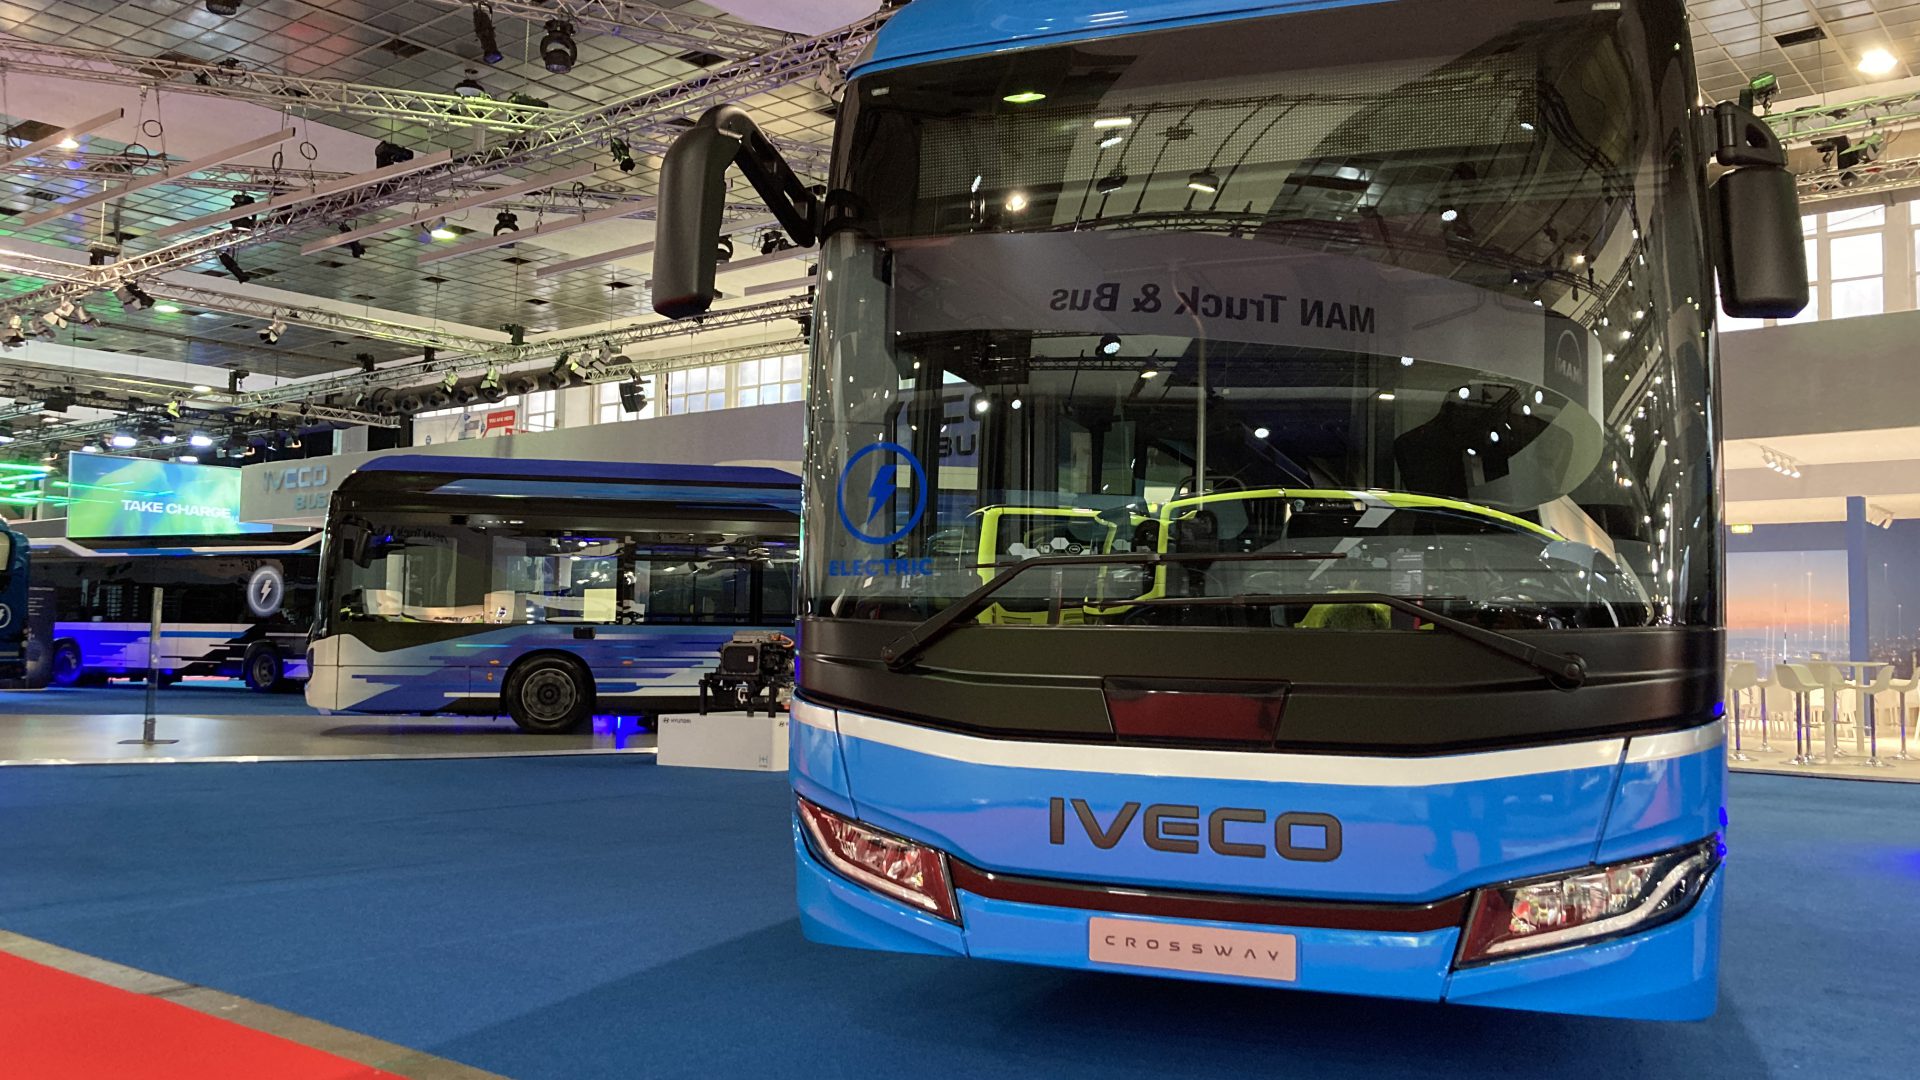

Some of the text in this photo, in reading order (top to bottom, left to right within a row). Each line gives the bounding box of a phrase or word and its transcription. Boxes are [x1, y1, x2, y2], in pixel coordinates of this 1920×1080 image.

[121, 500, 164, 514] TAKE
[166, 503, 232, 519] CHARGE
[294, 493, 328, 512] BUS
[828, 557, 935, 578] ELECTRIC
[1048, 796, 1343, 863] IVECO
[1105, 935, 1279, 962] CROSSWAY
